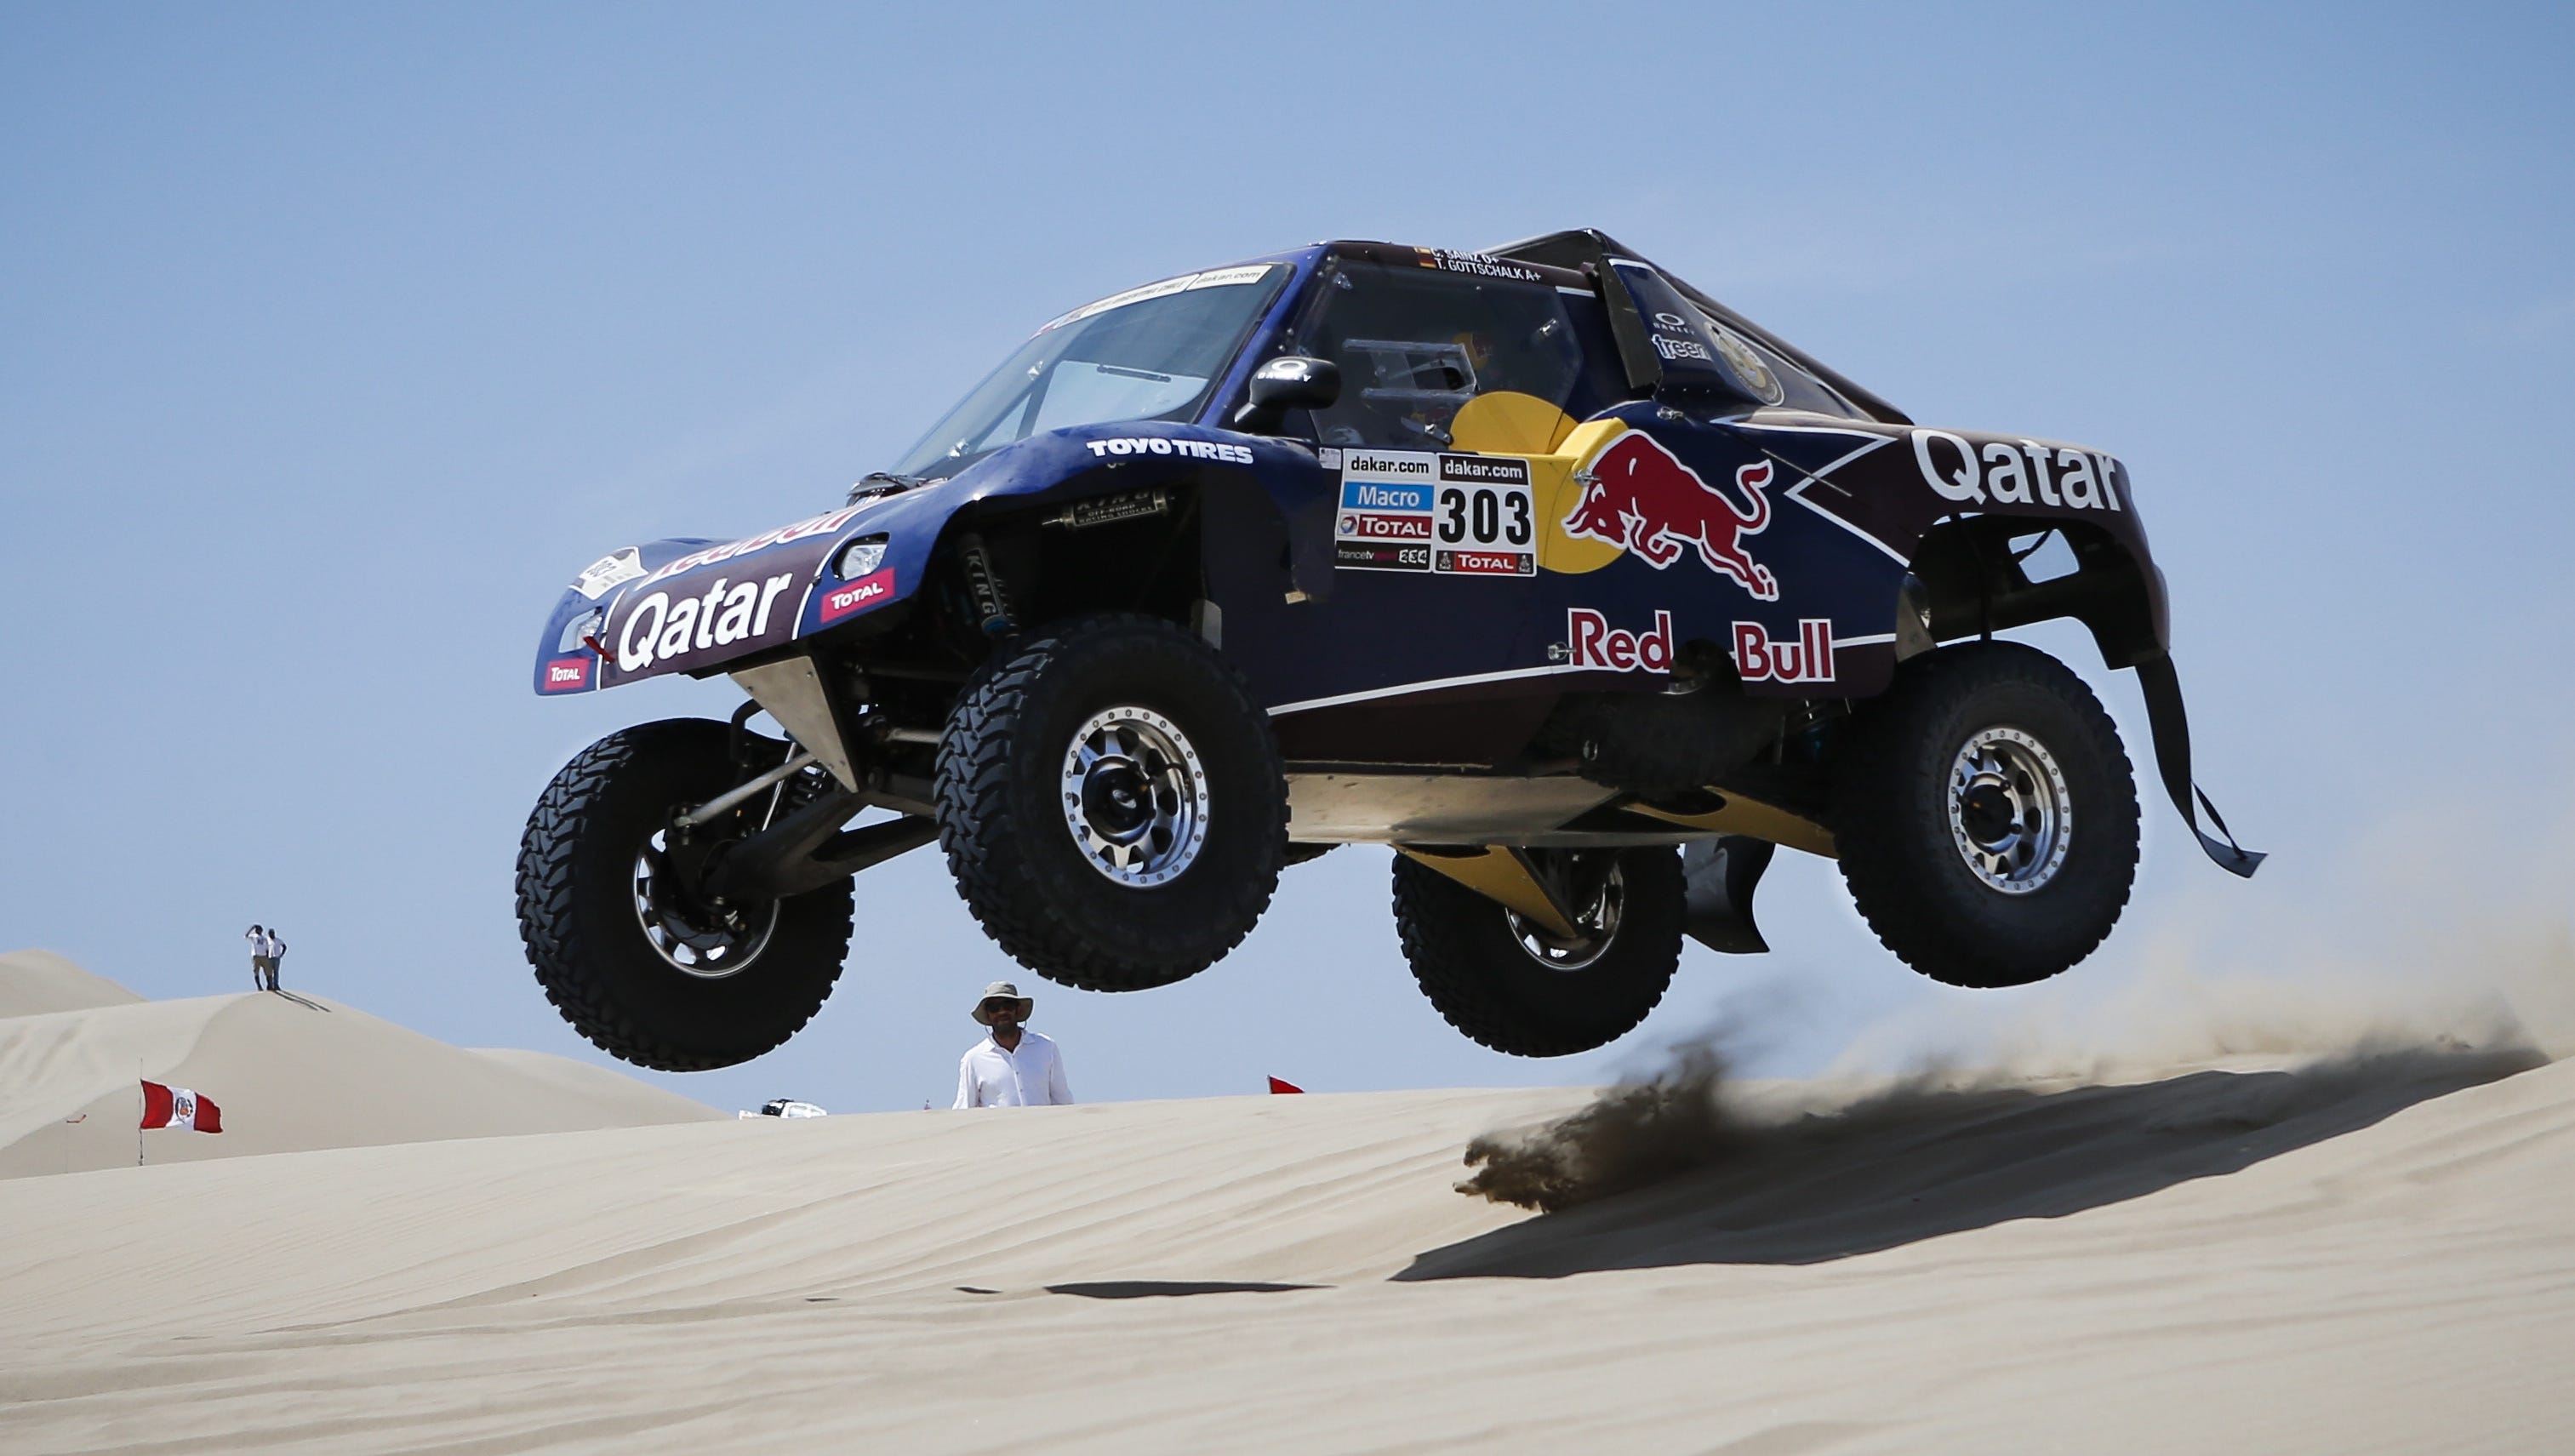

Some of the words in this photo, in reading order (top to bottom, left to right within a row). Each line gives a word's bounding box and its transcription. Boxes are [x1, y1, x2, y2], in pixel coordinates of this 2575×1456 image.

[1434, 257, 1447, 270] T.
[1448, 260, 1525, 280] GOTTSCHALK
[1526, 269, 1542, 282] A+
[1087, 437, 1173, 459] TOYO
[1170, 440, 1254, 465] TIRES
[1350, 455, 1430, 474] dakar.com
[1445, 459, 1523, 479] dakar.com
[1910, 428, 2122, 512] Qatar
[1357, 486, 1420, 507] Macro
[1362, 517, 1430, 536] TOTAL
[1438, 488, 1532, 545] 303
[1458, 553, 1514, 569] TOTAL
[831, 582, 885, 611] TOTAL
[618, 572, 794, 673] Qatar
[1567, 607, 1675, 674] Red
[1731, 618, 1836, 684] Bull
[550, 665, 581, 683] TOTAL
